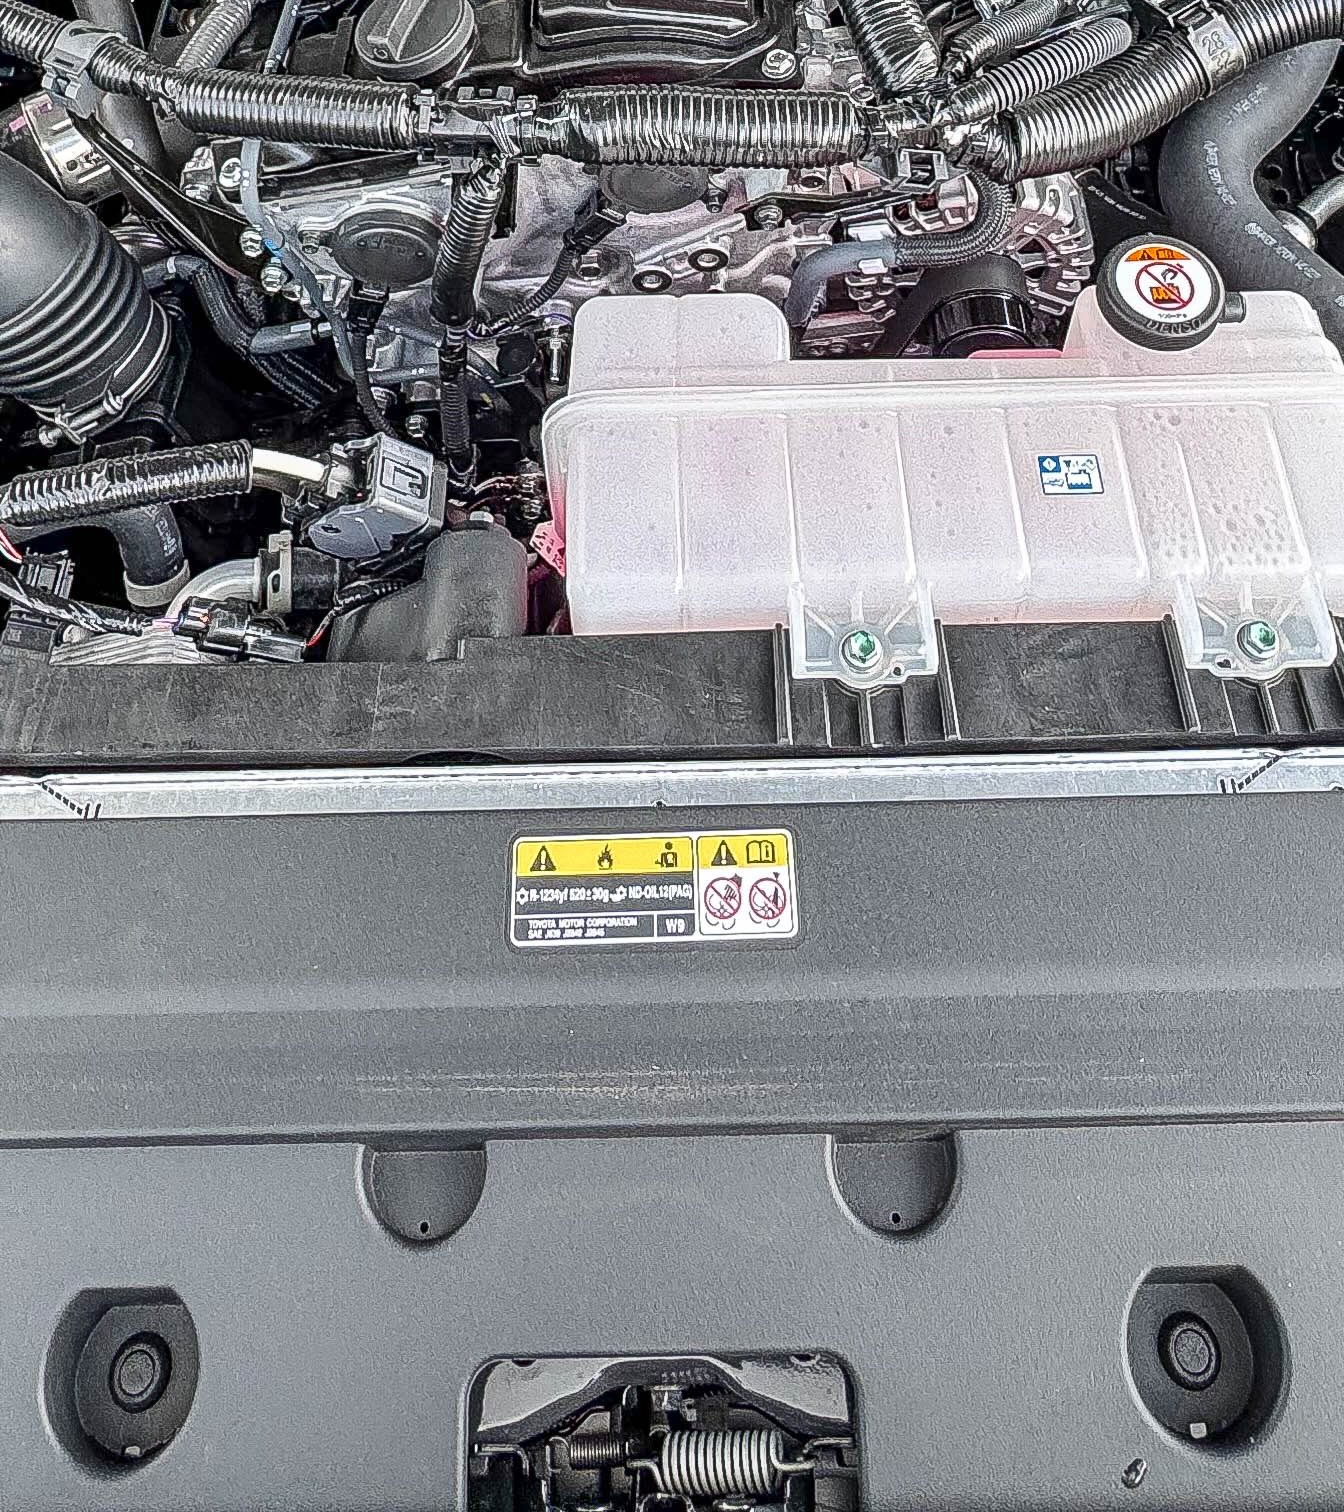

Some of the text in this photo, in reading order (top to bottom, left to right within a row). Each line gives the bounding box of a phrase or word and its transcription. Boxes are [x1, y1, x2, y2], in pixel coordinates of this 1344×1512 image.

[1201, 30, 1225, 57] 28
[1145, 319, 1202, 335] DENSO
[529, 887, 569, 904] R-1234yf
[527, 916, 638, 929] TOYOTA MOTOR CORPORATION
[664, 917, 686, 934] W9
[527, 929, 544, 940] SAE
